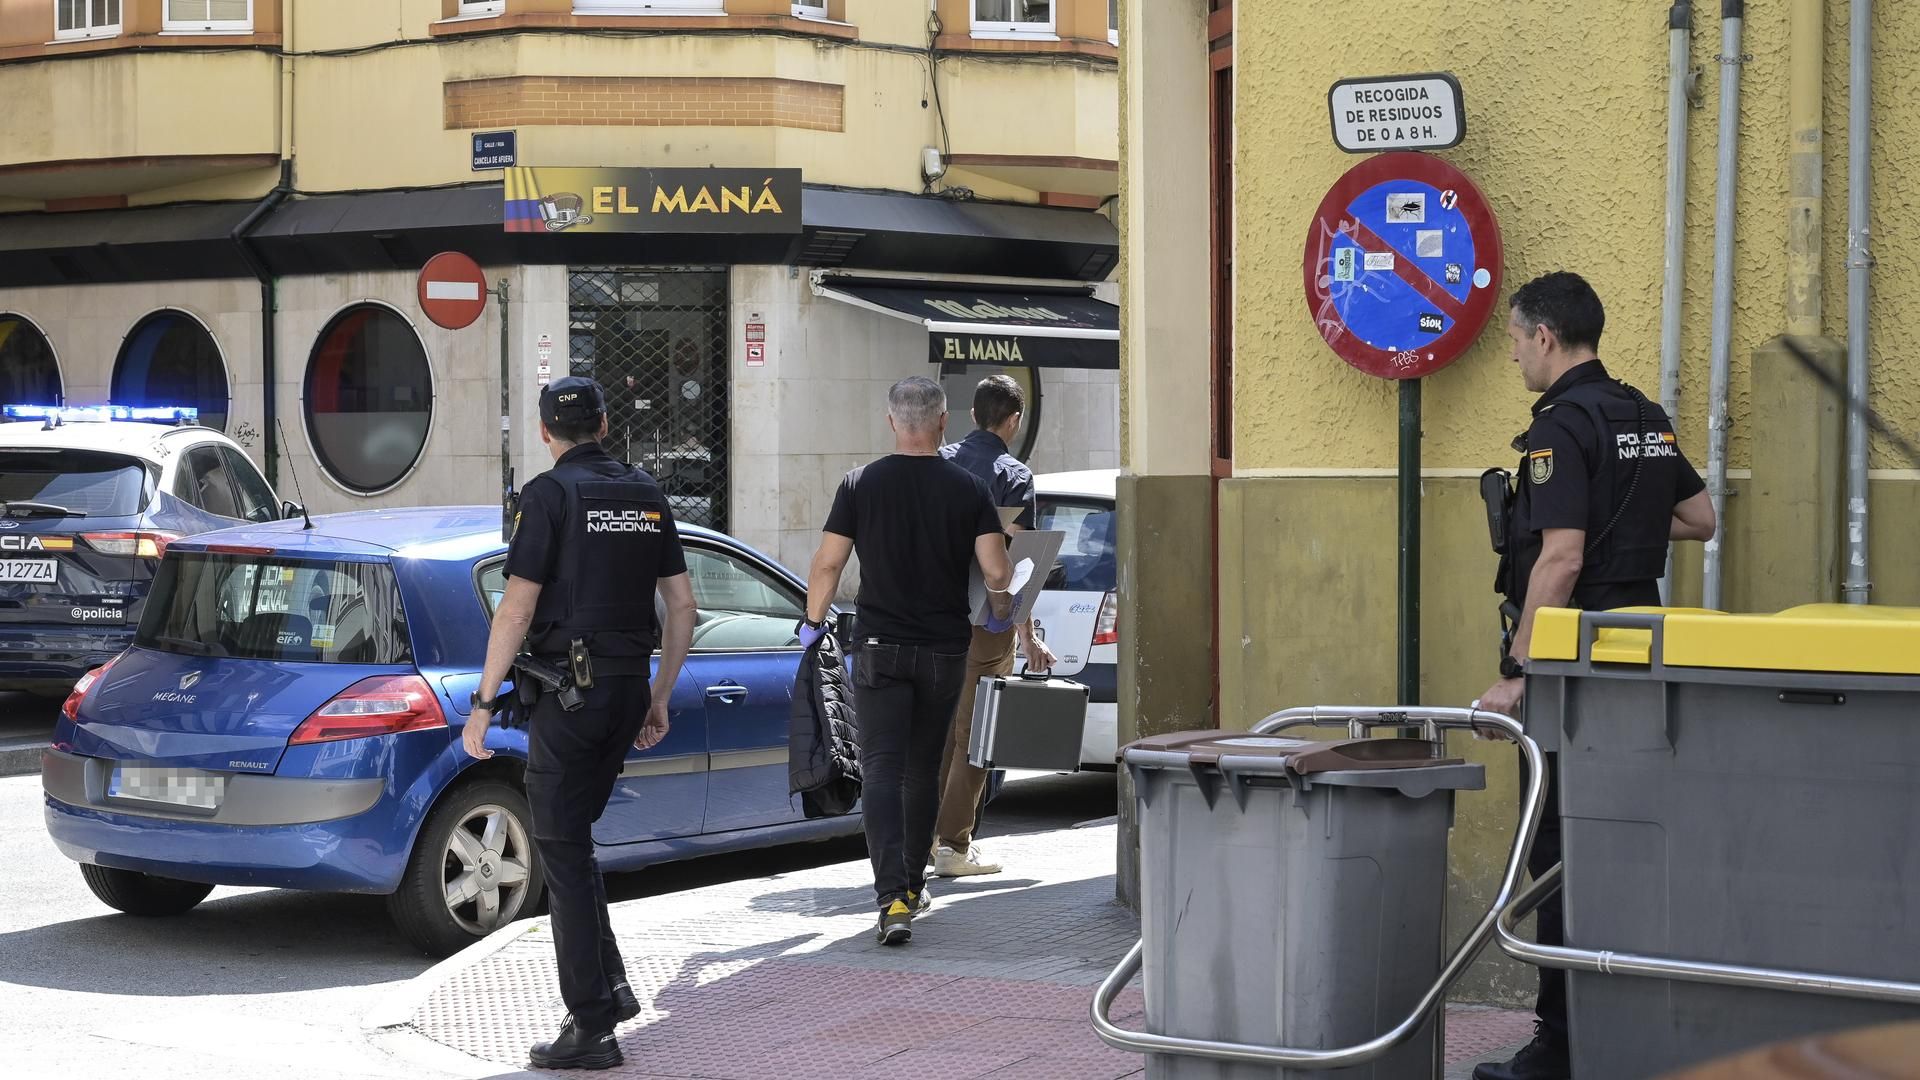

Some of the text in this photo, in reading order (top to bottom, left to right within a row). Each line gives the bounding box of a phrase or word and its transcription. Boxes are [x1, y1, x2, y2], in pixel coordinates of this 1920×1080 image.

[1354, 86, 1429, 104] RECOGIDA
[1346, 106, 1443, 124] DE RESIDUOS
[1357, 128, 1376, 142] DE
[1395, 127, 1405, 140] A
[1410, 126, 1419, 139] 8
[1423, 125, 1437, 139] H.
[474, 155, 514, 165] CANCELA DE AFUERA
[592, 177, 783, 215] EL MANÁ
[943, 336, 1023, 362] EL MANÁ
[558, 393, 578, 402] CNP
[587, 510, 648, 521] POLICIA
[587, 521, 661, 533] NACIONAL
[71, 607, 123, 620] @policia
[276, 636, 294, 645] elf
[152, 691, 197, 704] MEGANE
[229, 760, 268, 770] RENAULT
